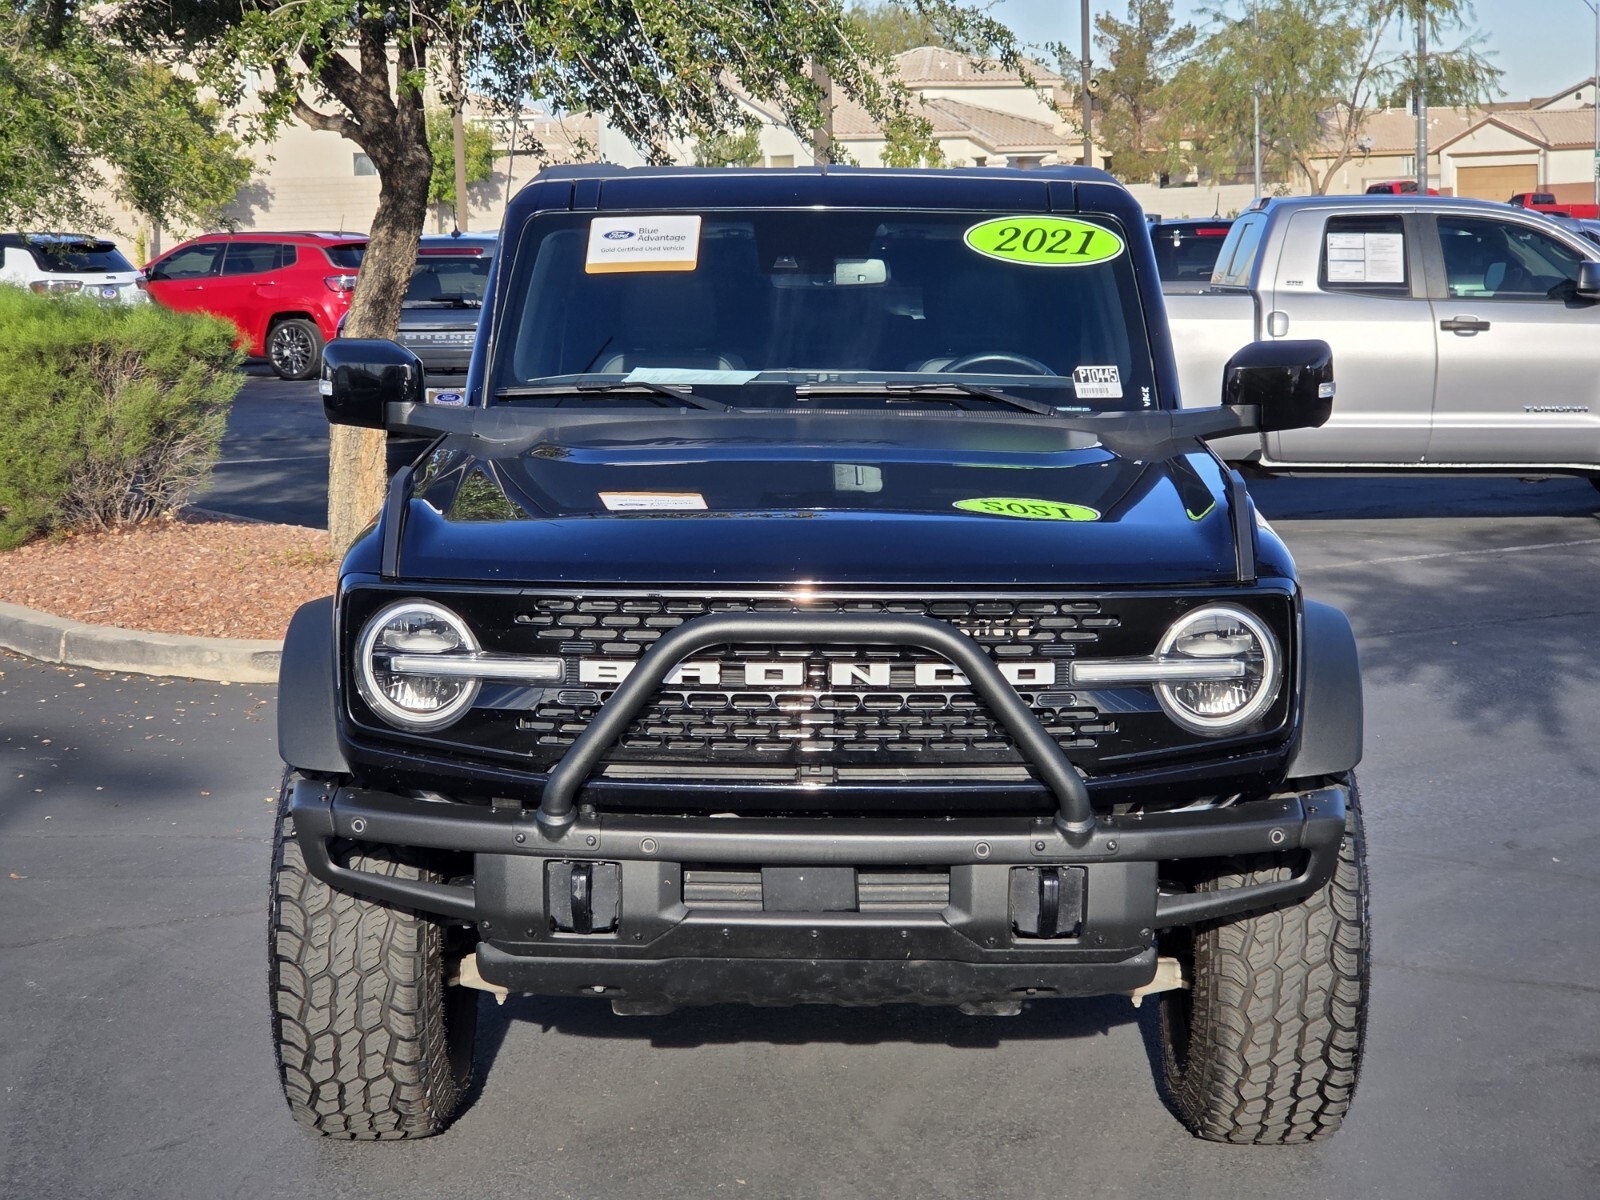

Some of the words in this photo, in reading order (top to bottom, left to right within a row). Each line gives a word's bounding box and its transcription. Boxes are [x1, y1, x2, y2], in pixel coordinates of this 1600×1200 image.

[637, 234, 686, 242] Advantage
[993, 227, 1096, 256] 2021
[1079, 369, 1118, 383] P10445
[579, 660, 1055, 686] BRONCO
